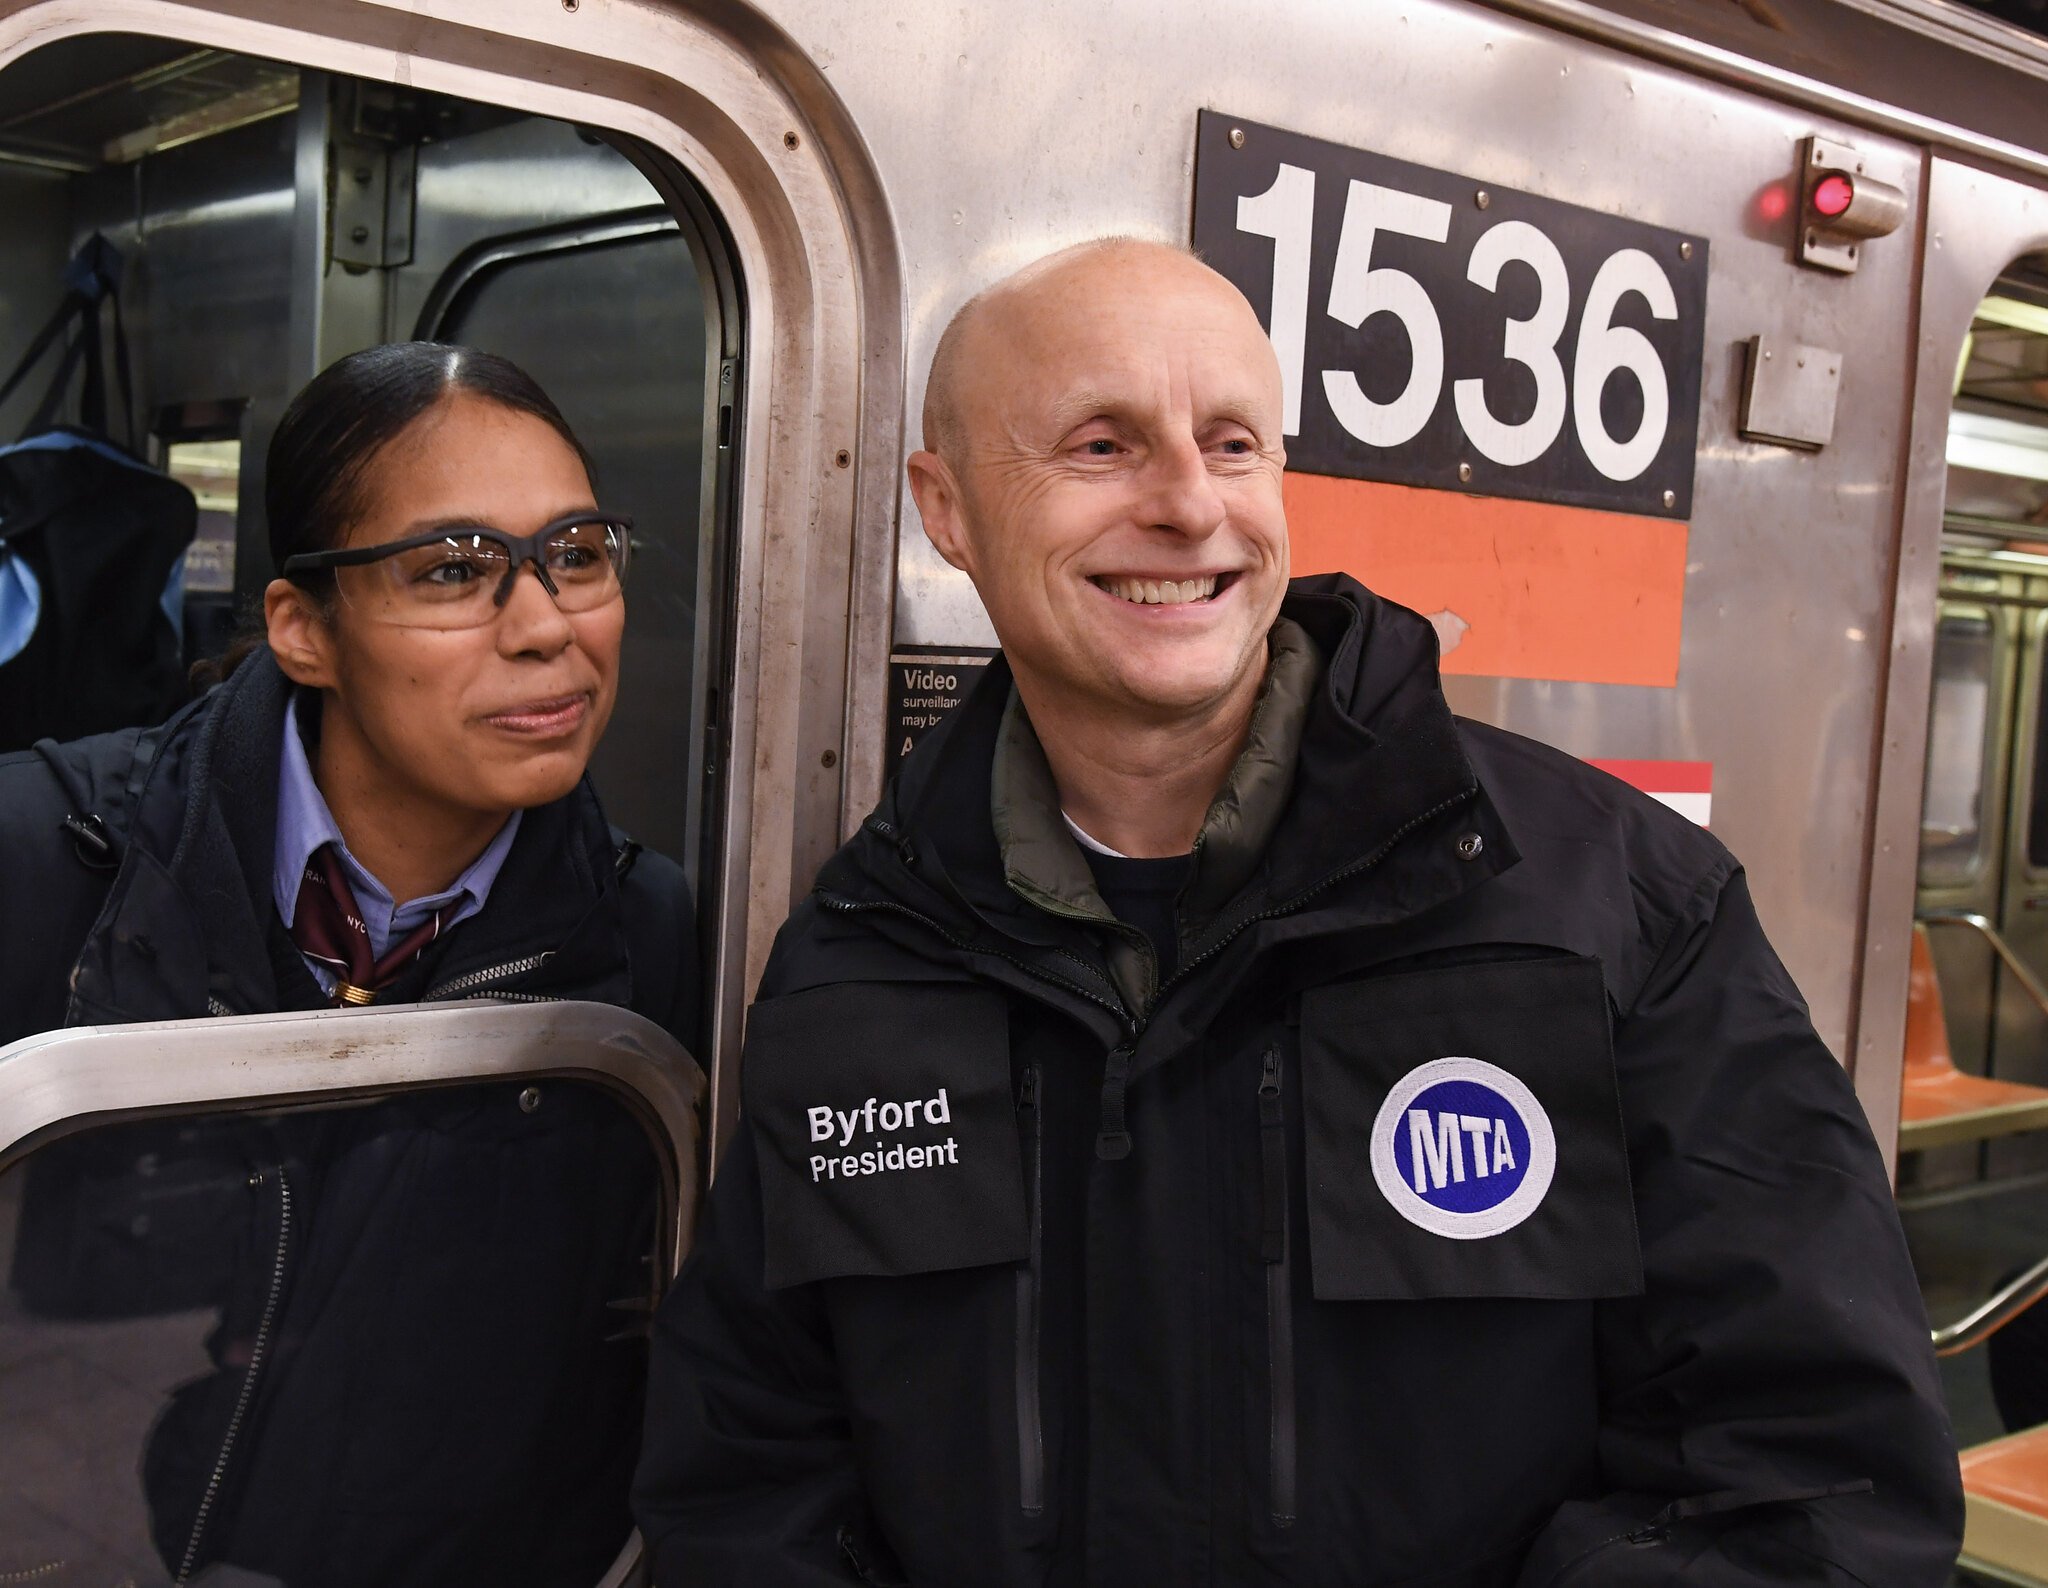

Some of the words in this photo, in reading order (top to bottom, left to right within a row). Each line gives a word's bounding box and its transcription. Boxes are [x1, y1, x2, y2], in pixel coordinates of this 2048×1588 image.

[1236, 162, 1679, 482] 1536
[904, 669, 957, 690] Video
[903, 696, 961, 708] surveillan
[902, 715, 926, 728] may
[347, 915, 366, 934] NYC
[807, 1088, 951, 1147] Byford
[809, 1137, 959, 1183] President
[1408, 1109, 1516, 1194] MTA
